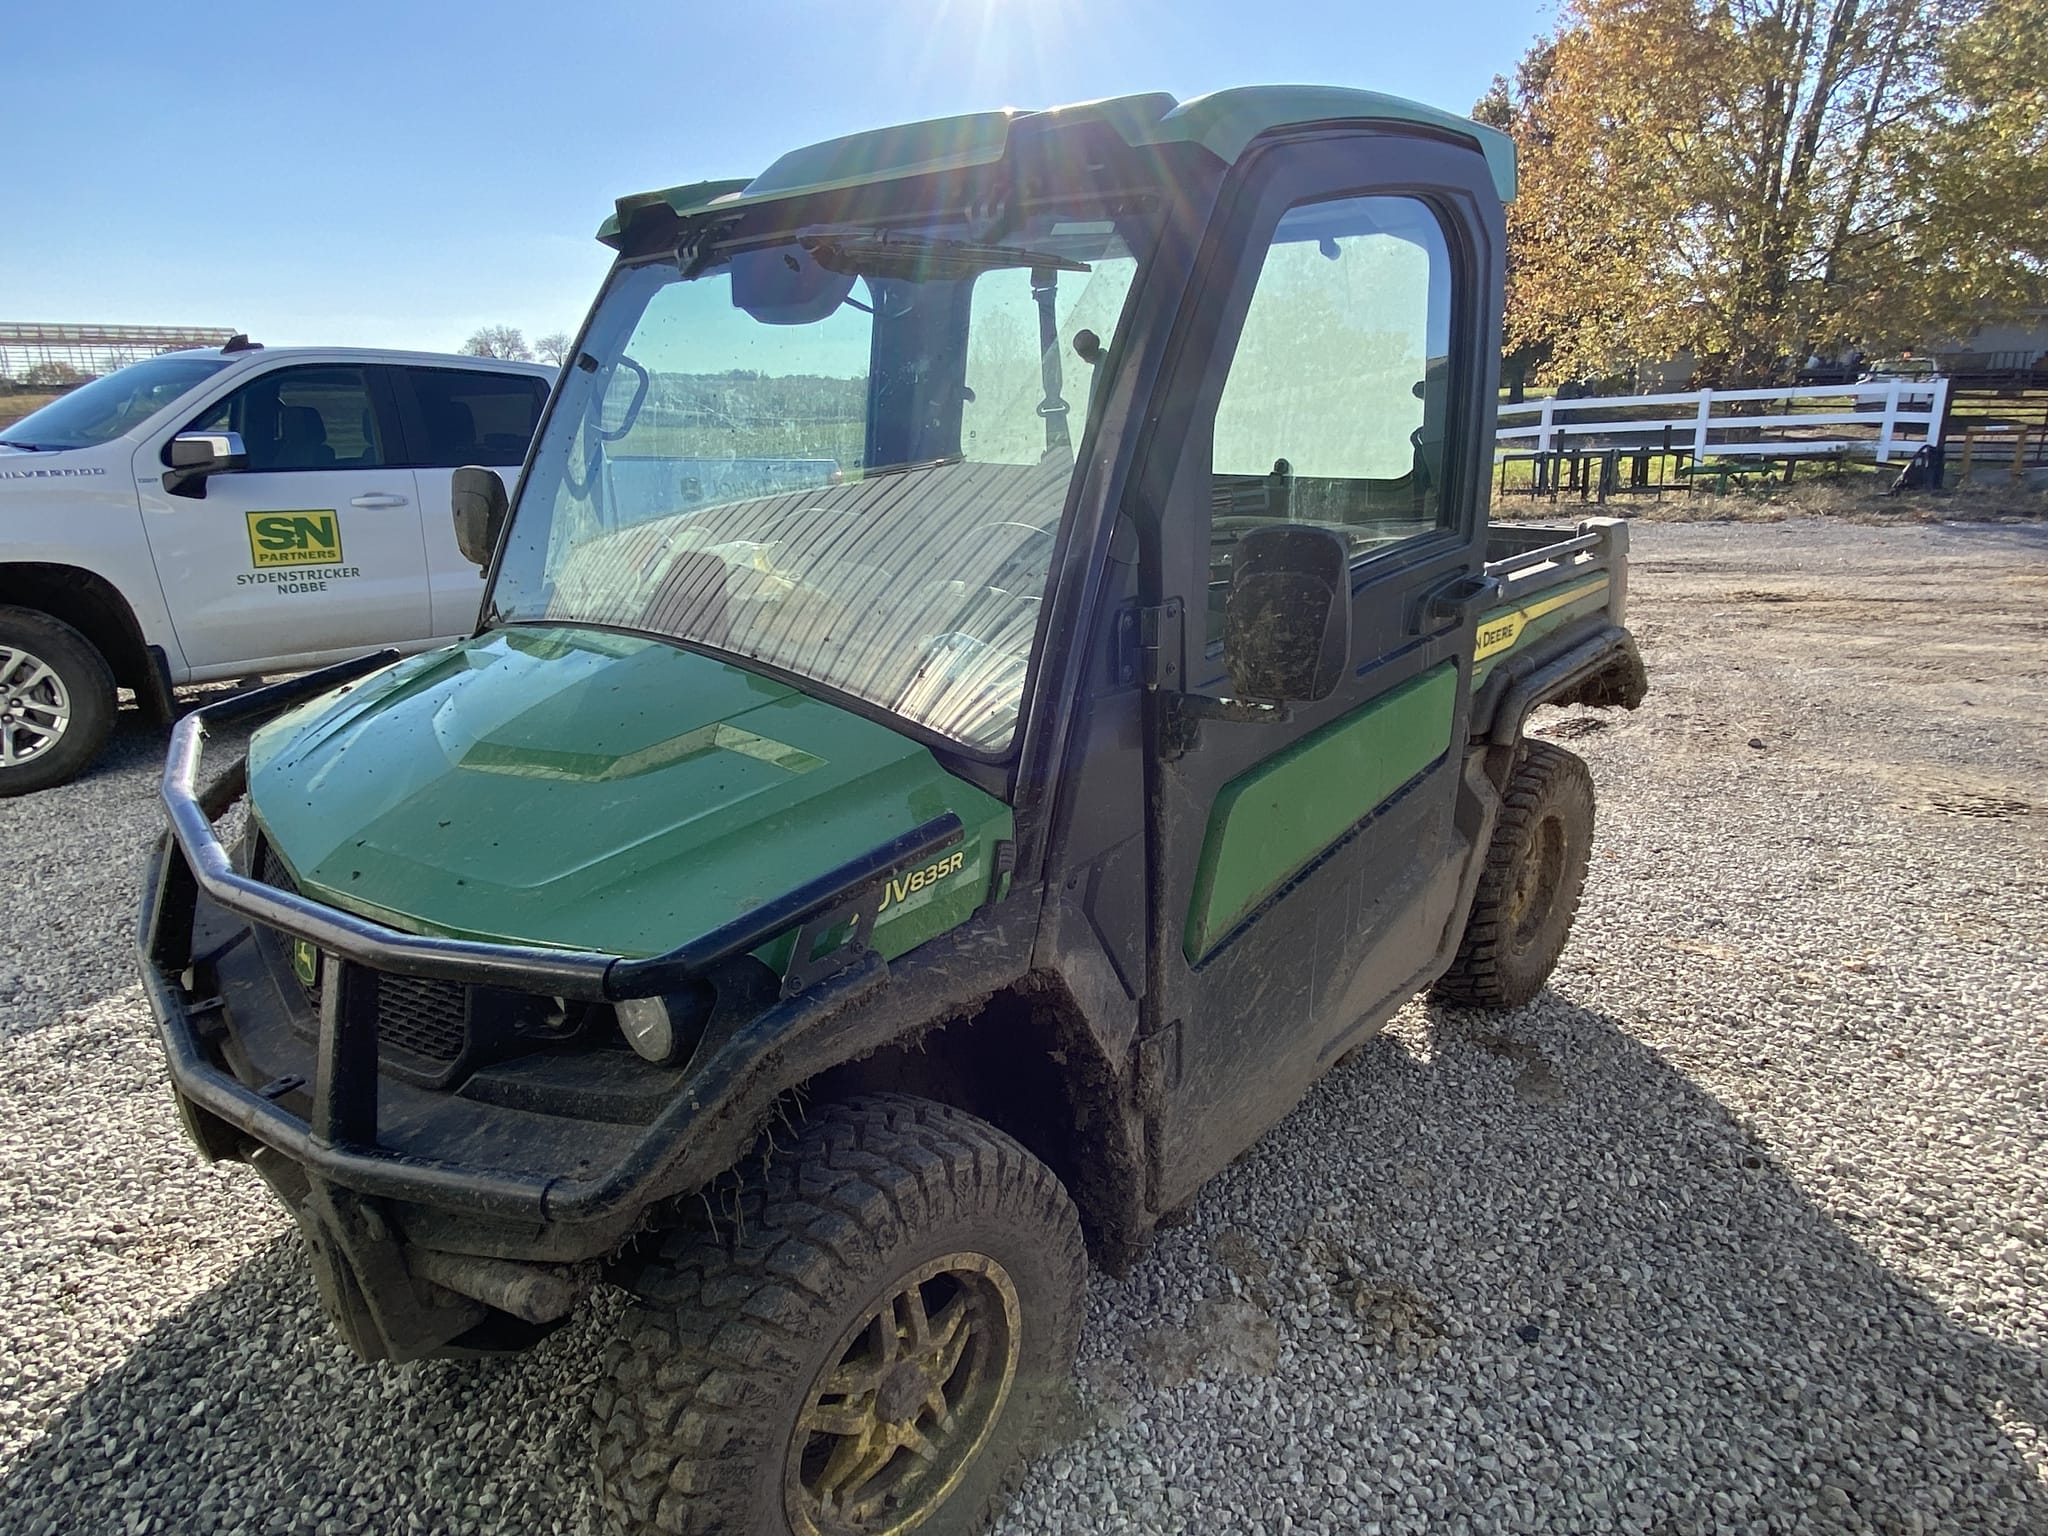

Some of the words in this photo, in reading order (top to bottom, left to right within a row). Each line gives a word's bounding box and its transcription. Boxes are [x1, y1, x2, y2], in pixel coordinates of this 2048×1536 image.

[258, 550, 337, 562] PARTNERS
[236, 567, 361, 586] SYDENSTRICKER
[277, 581, 328, 595] NOBBE
[1483, 623, 1514, 648] DEERE
[877, 851, 964, 912] JV835R
